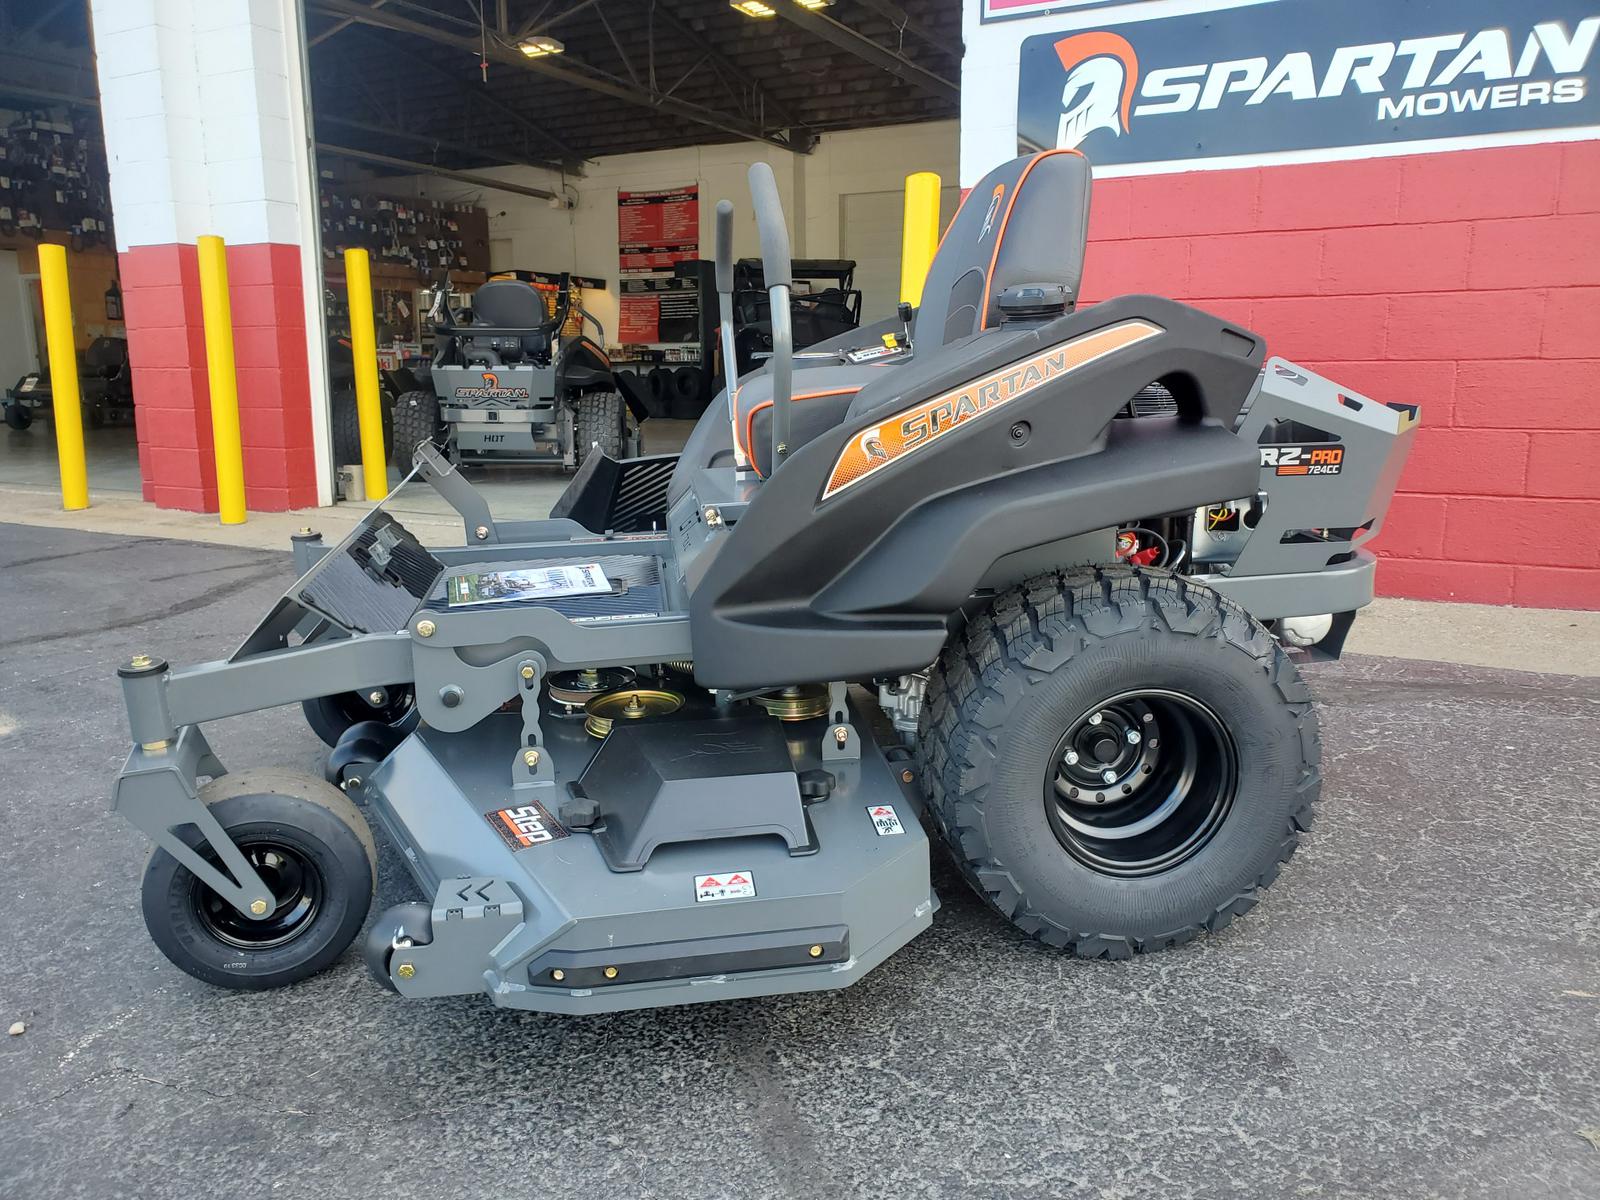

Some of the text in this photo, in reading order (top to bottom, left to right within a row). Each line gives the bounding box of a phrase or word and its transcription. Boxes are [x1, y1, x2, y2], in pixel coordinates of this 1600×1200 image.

[1133, 16, 1600, 117] SPARTAN
[1377, 79, 1585, 121] MOWERS
[902, 351, 1066, 448] SPARTAN
[1260, 447, 1343, 467] RZ-PRO
[1308, 465, 1340, 475] 724CC
[504, 805, 553, 843] Step
